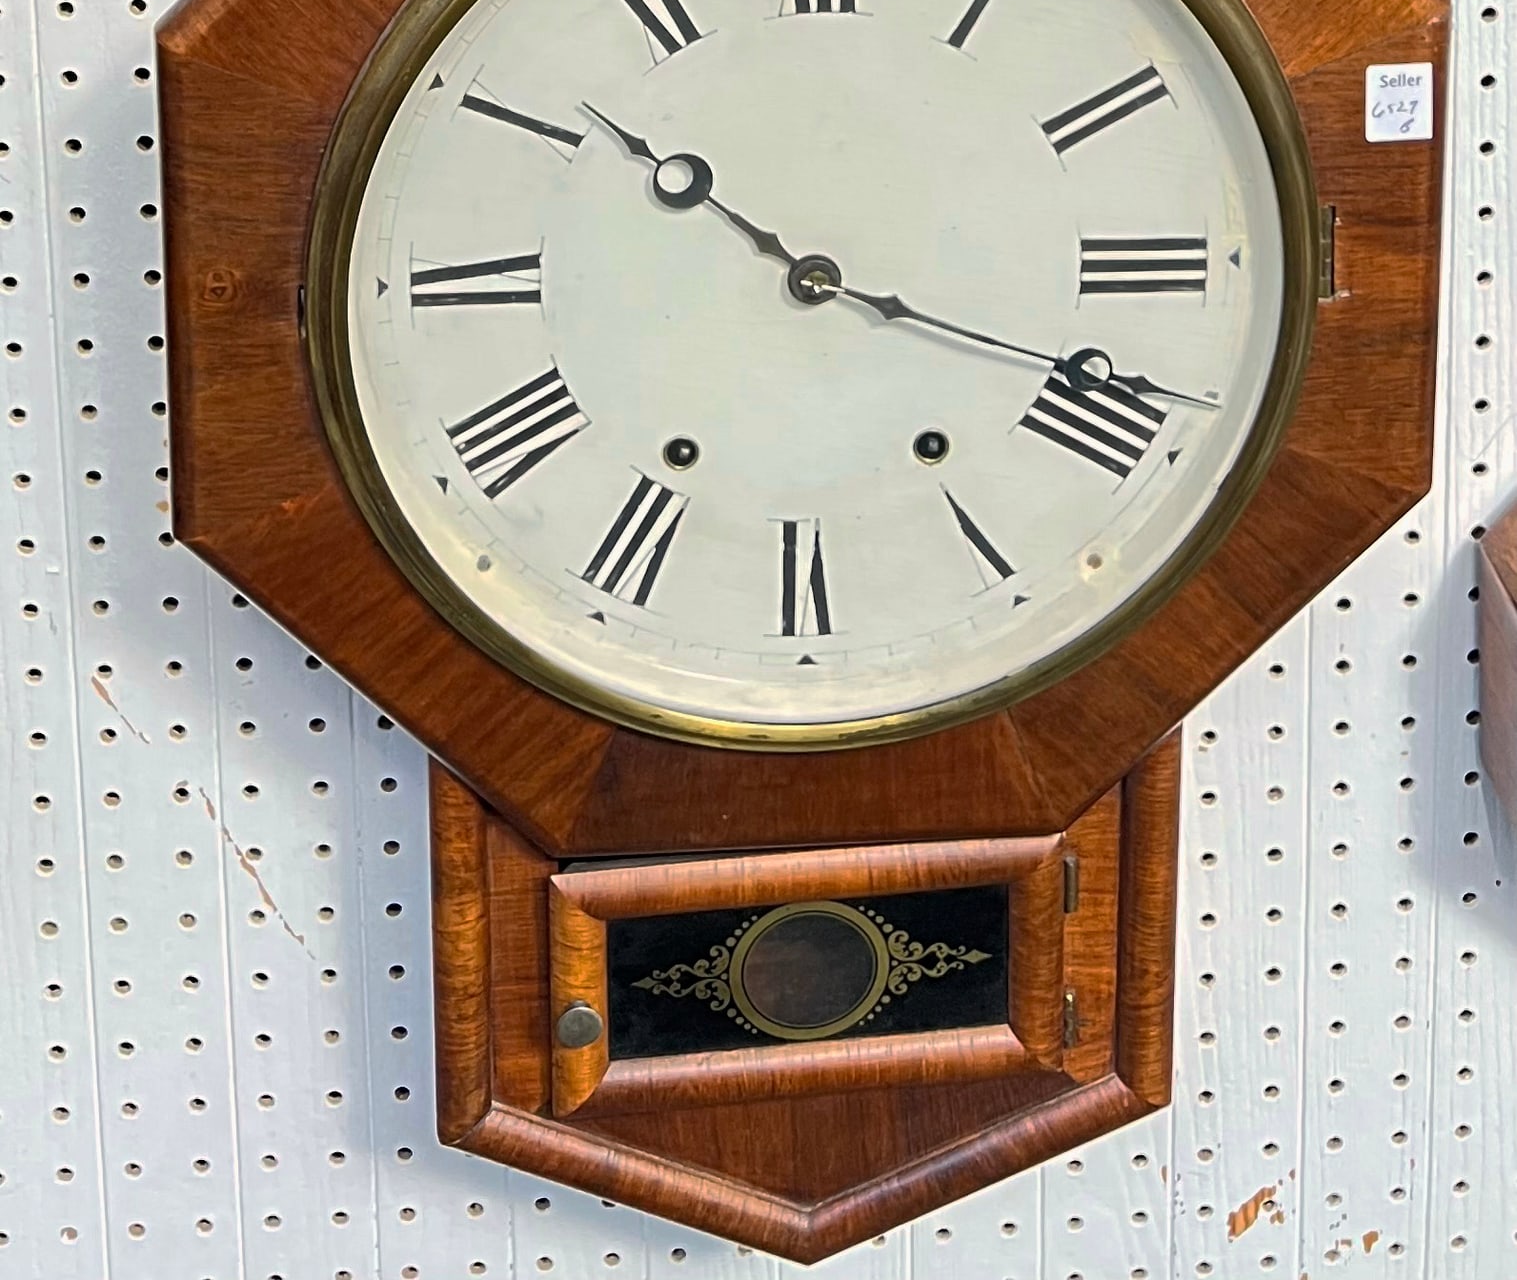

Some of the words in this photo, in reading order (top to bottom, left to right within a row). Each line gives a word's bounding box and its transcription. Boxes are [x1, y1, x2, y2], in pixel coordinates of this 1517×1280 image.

[450, 64, 594, 164] X
[1030, 58, 1179, 172] II
[1379, 73, 1422, 88] Seller
[409, 235, 546, 329] IX
[1075, 218, 1209, 309] III
[439, 353, 593, 500] VIII
[565, 464, 691, 618] VII
[763, 516, 850, 638] VI
